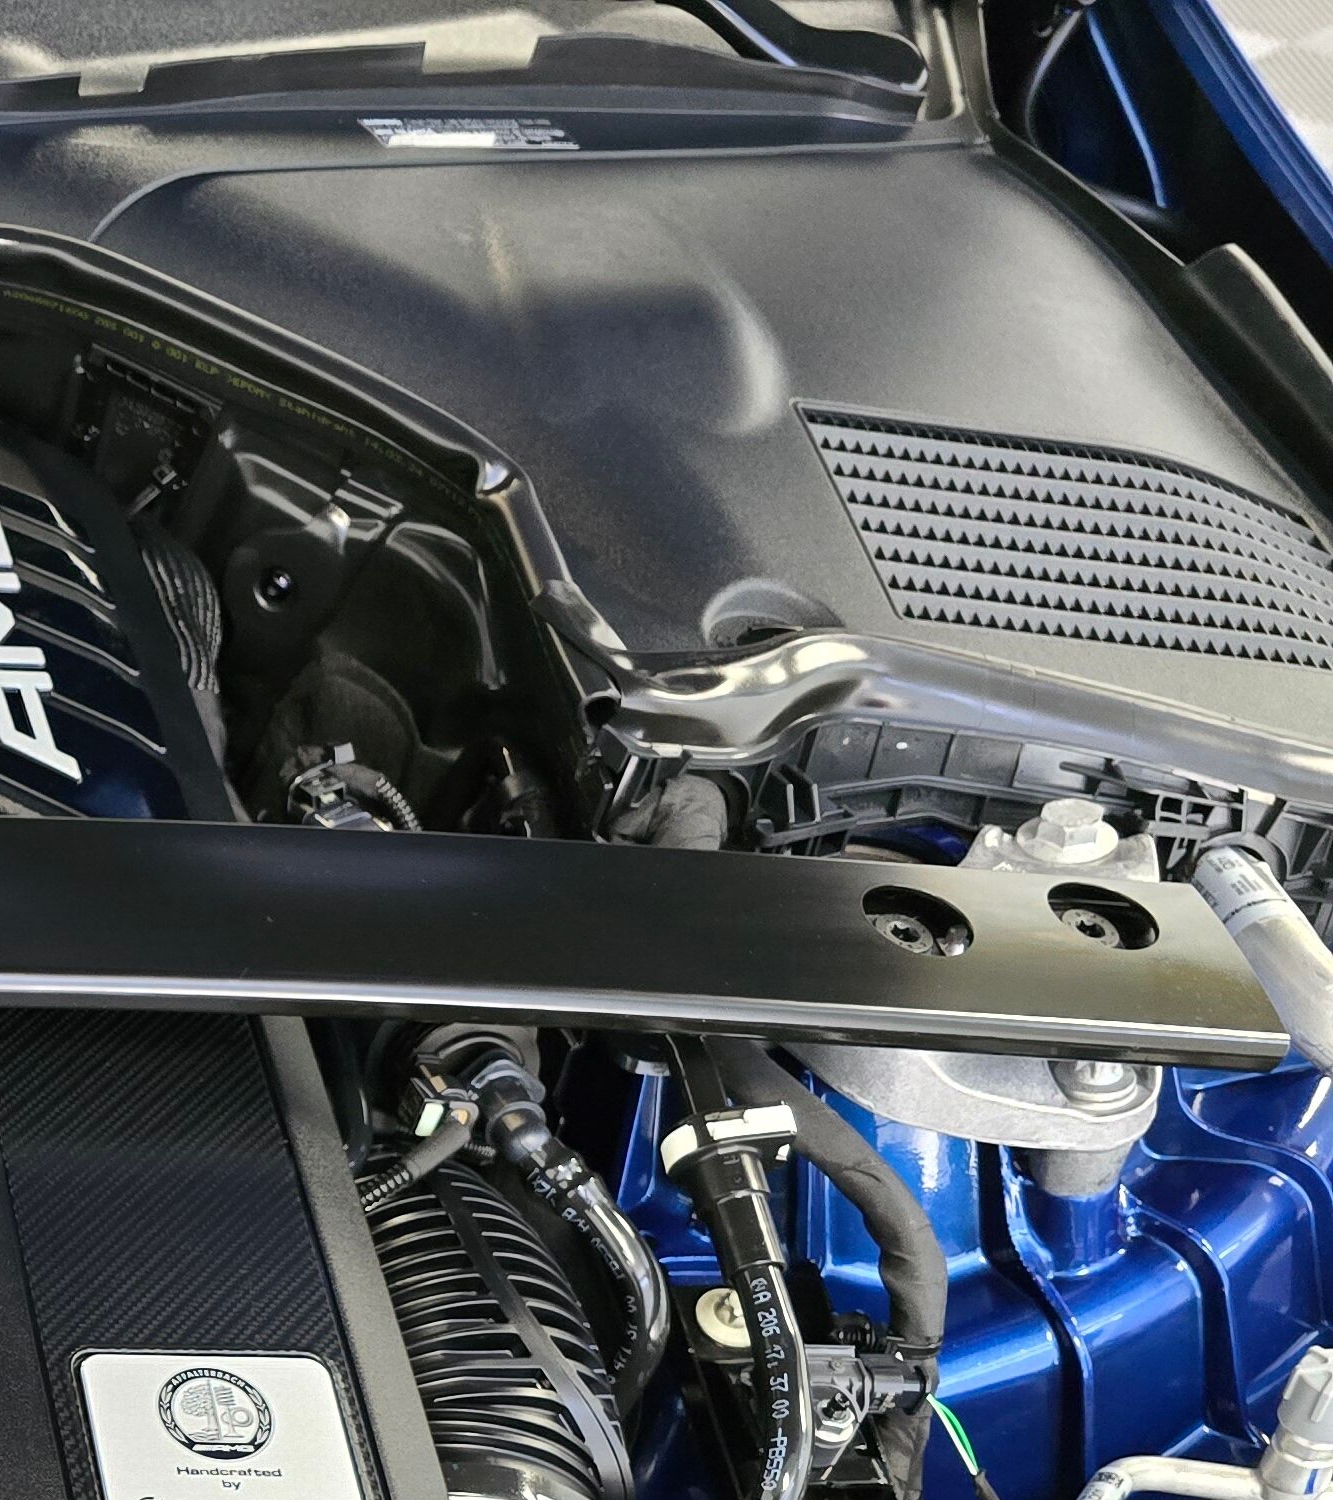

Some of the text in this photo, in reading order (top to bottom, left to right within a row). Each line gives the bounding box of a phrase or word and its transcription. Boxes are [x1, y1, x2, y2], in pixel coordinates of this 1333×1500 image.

[757, 1307, 781, 1338] 206
[769, 1372, 789, 1393] 37
[170, 1369, 246, 1387] AFFALTERBACH
[176, 1466, 283, 1477] Handcrafted
[221, 1480, 242, 1490] by
